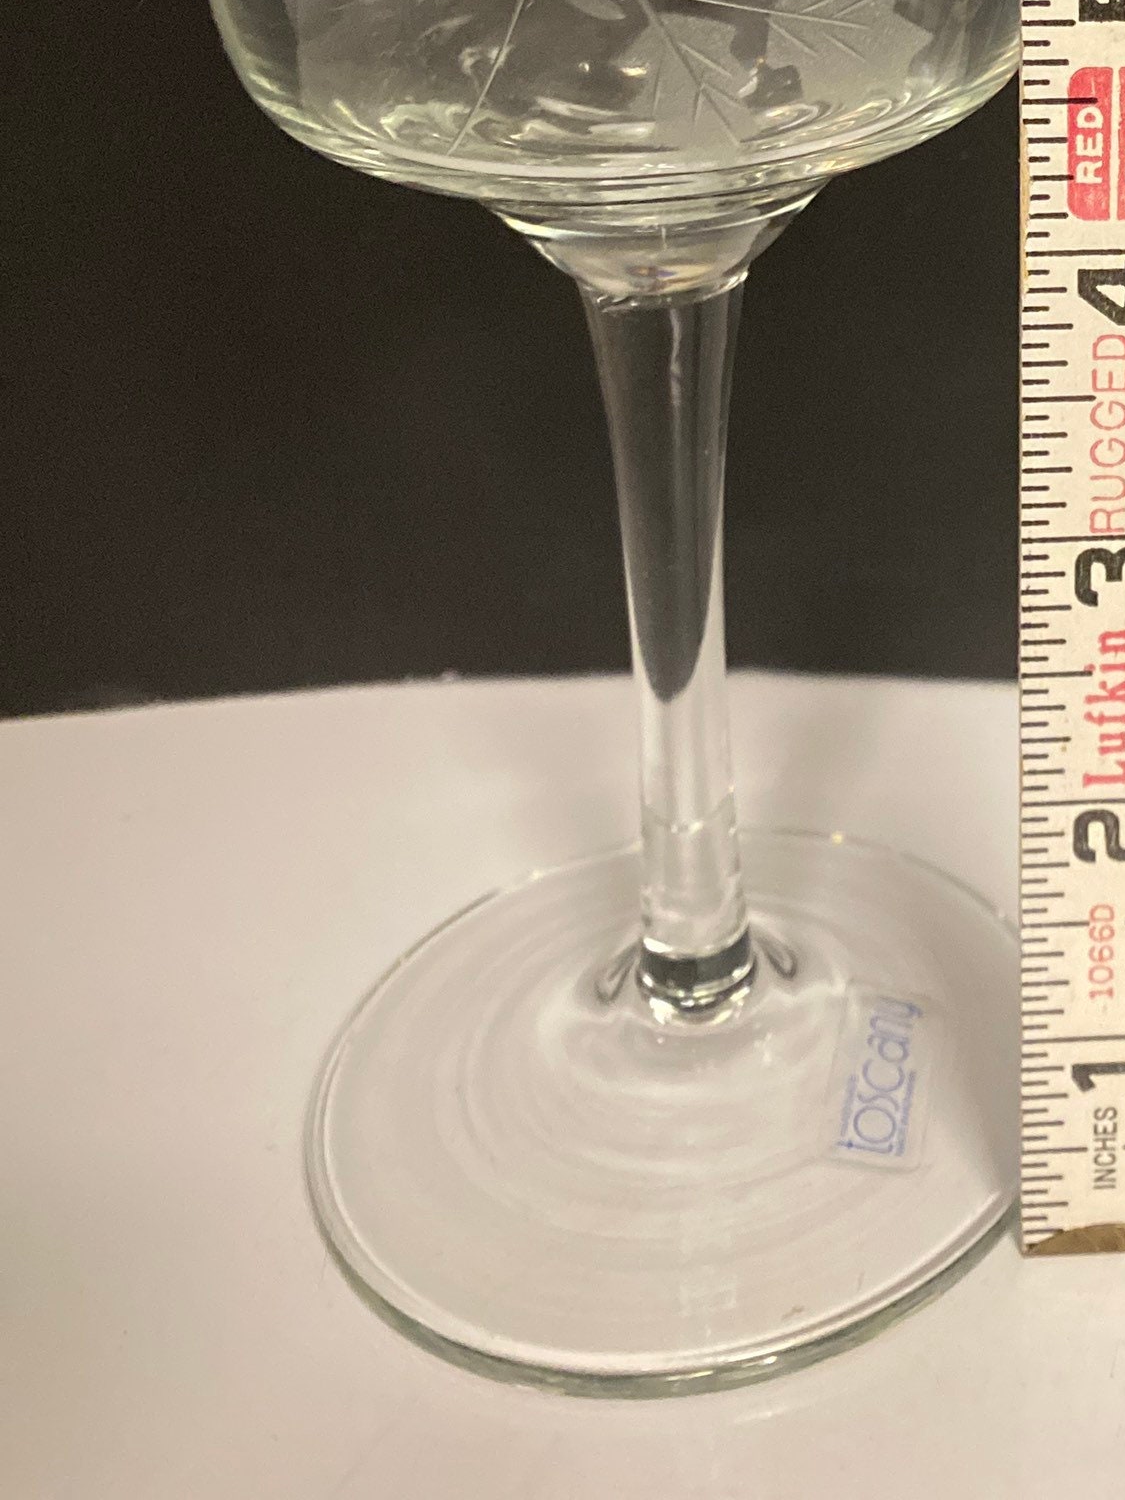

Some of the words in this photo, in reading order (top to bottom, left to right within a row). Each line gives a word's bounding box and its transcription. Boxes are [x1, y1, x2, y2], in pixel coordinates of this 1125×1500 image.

[1075, 106, 1104, 184] RED
[1088, 903, 1116, 1000] 1066D
[1093, 1106, 1118, 1190] INCHES
